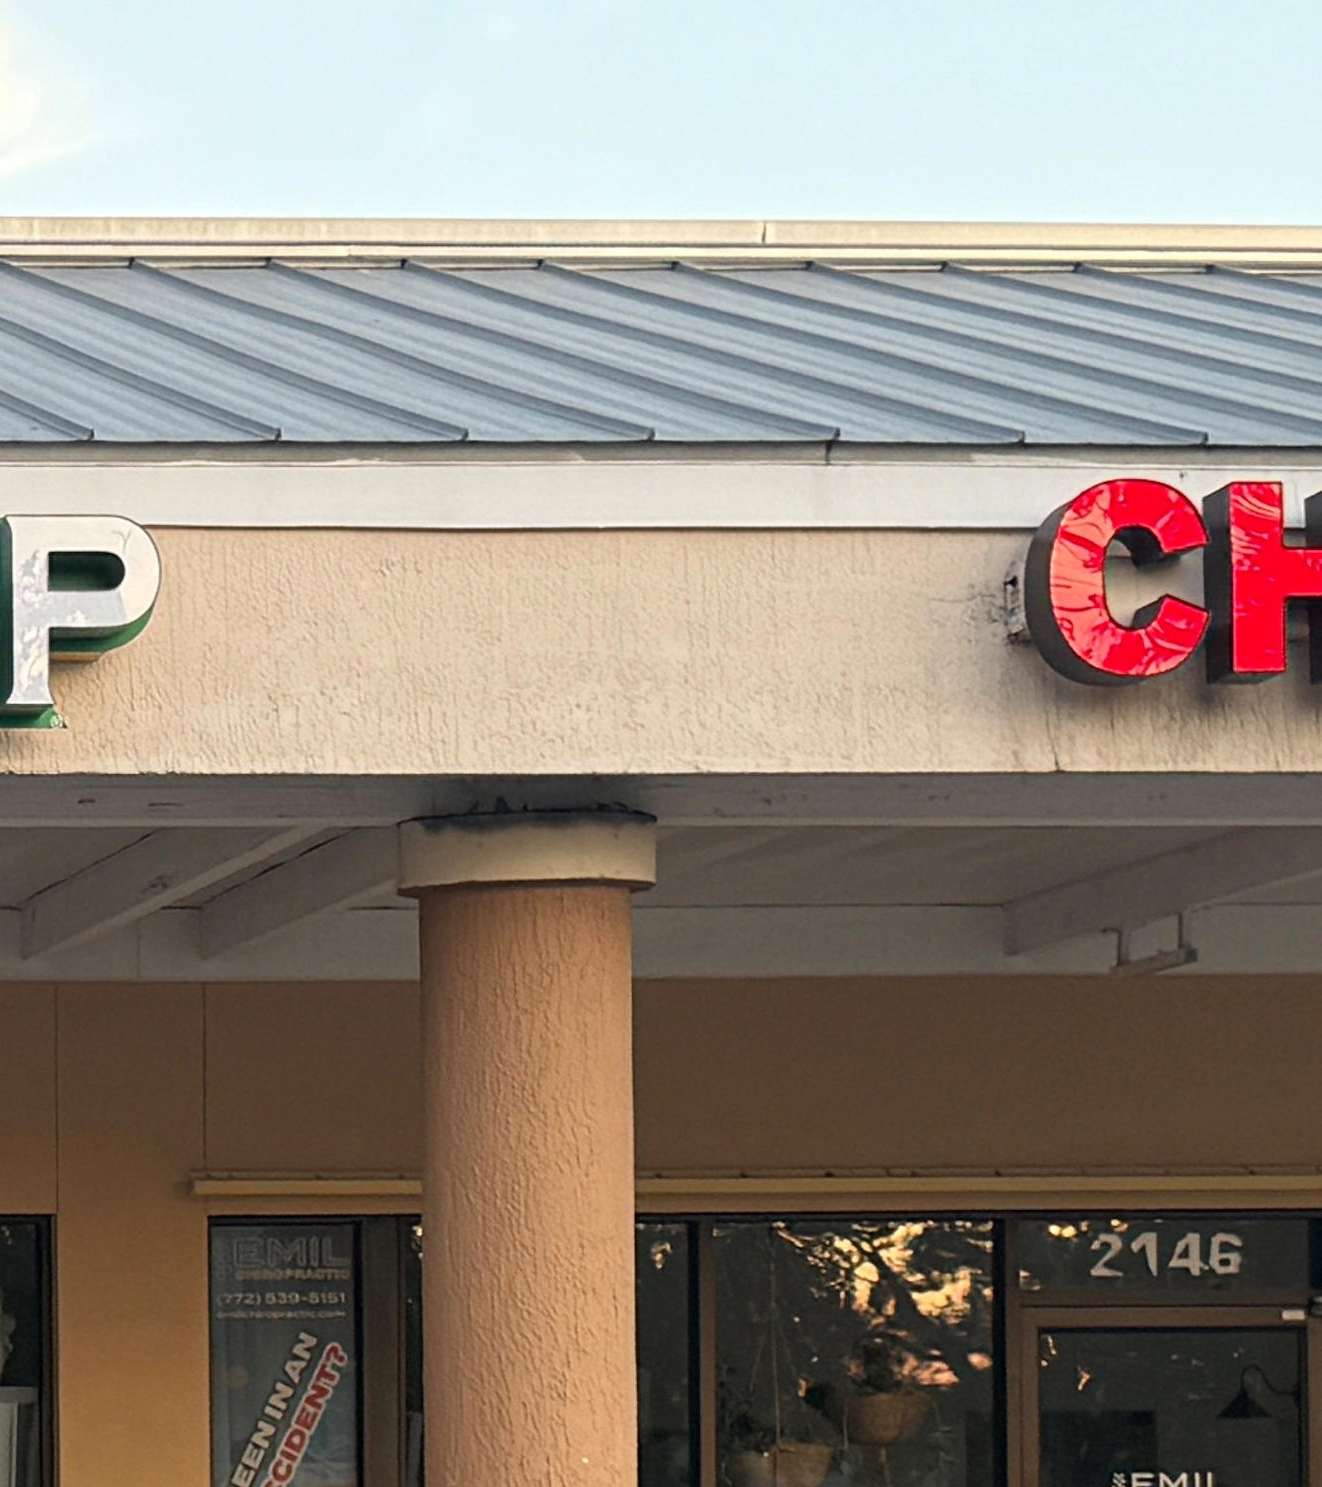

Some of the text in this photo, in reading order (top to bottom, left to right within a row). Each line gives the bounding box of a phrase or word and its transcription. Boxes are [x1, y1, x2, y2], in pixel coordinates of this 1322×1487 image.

[233, 1235, 352, 1268] EMIL
[1090, 1231, 1243, 1277] 2146
[264, 1381, 295, 1421] IN
[284, 1331, 318, 1384] AN
